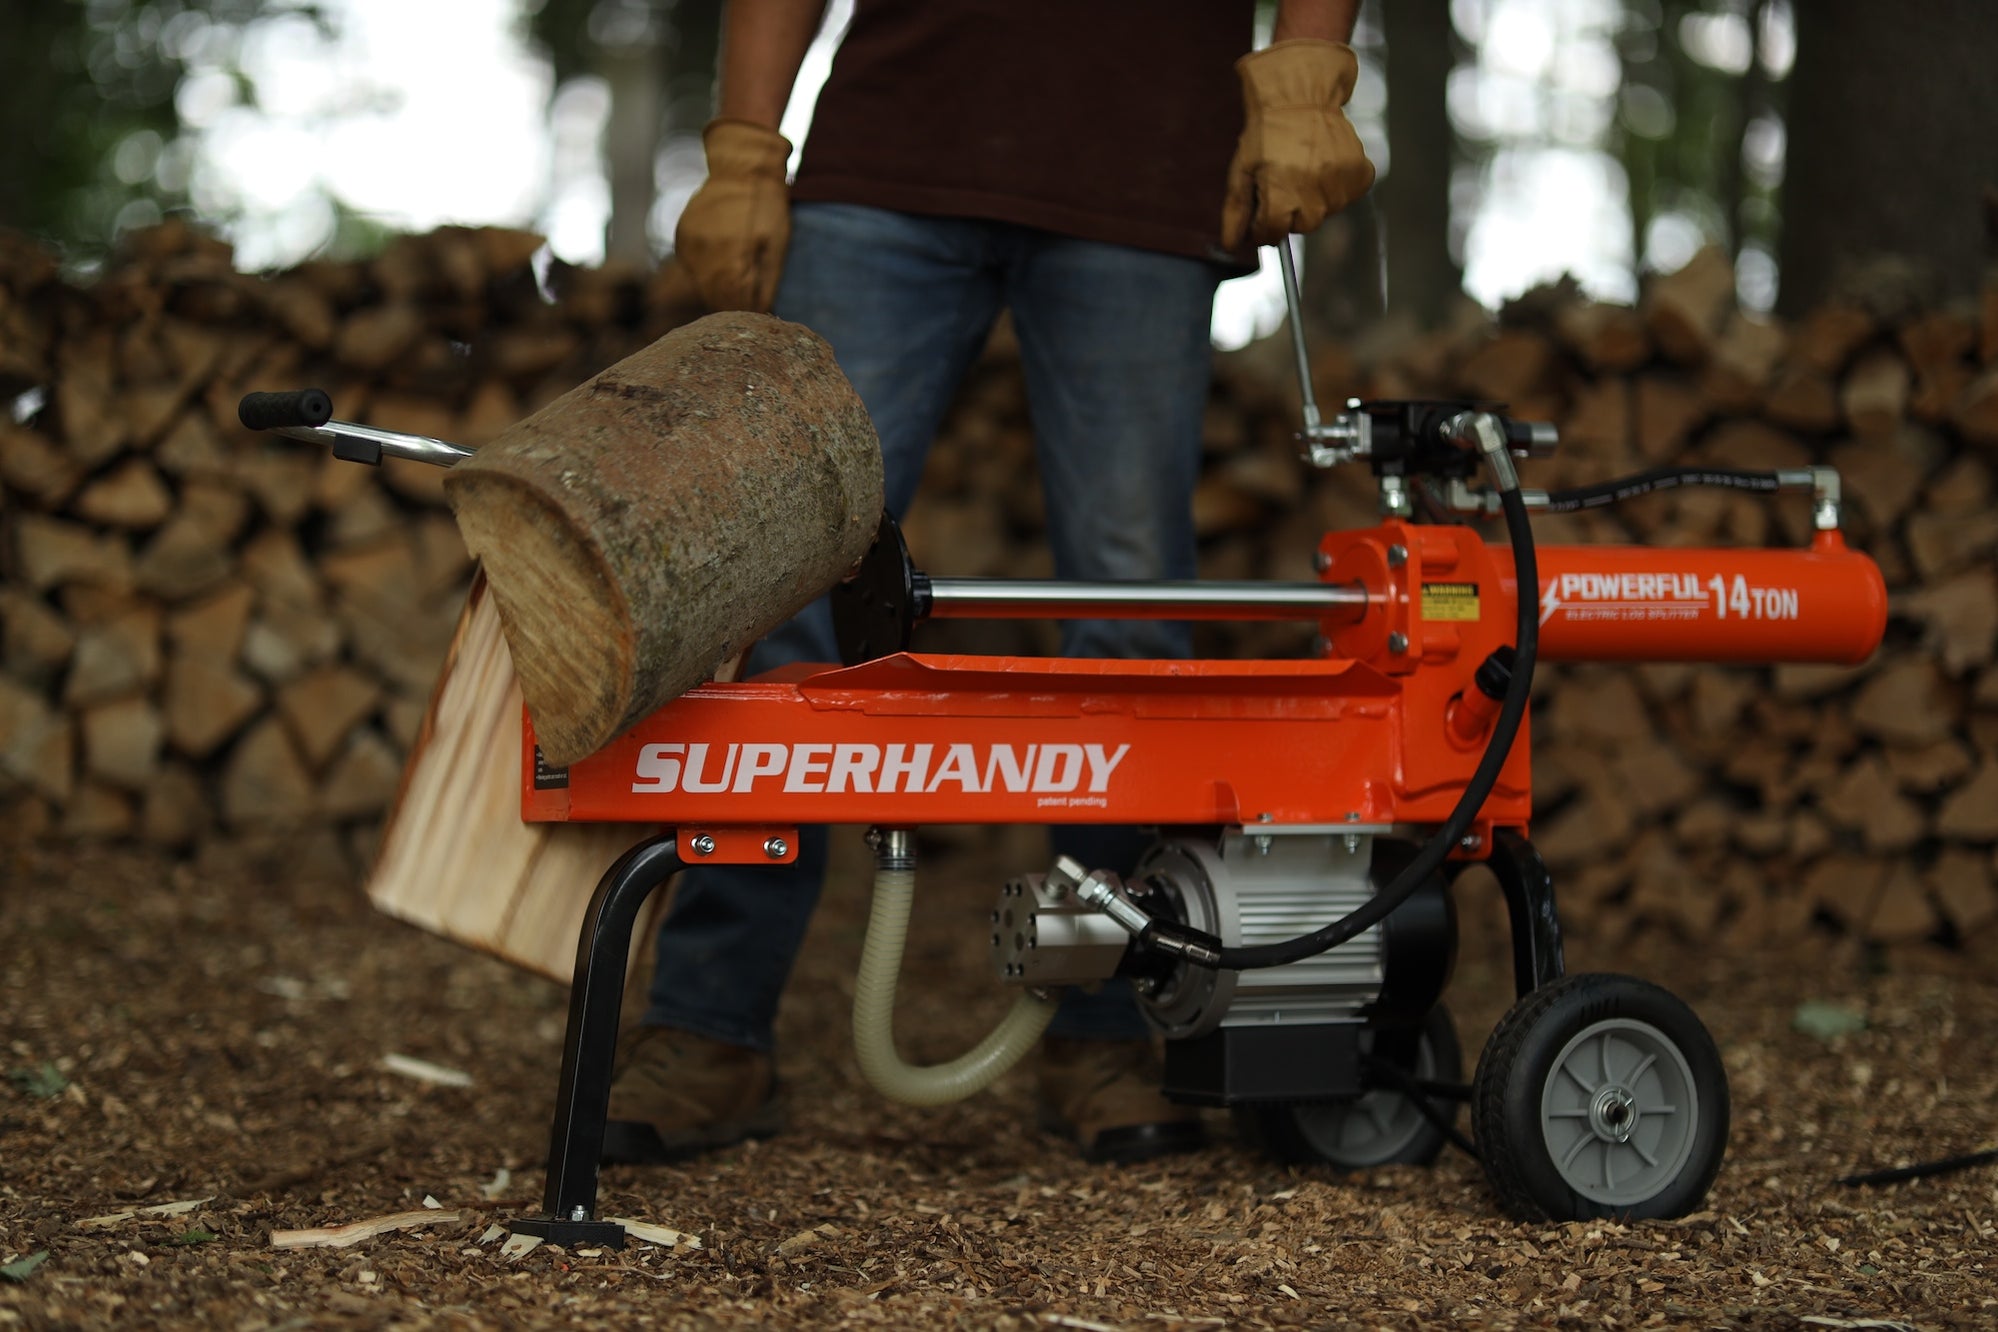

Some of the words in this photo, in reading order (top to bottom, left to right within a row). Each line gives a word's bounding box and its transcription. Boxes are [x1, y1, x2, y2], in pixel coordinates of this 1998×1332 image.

[1430, 584, 1474, 595] WARNING
[1561, 573, 1709, 600] POWERFUL
[1565, 609, 1619, 621] ELECTRIC
[1621, 609, 1646, 621] LOG
[1647, 609, 1699, 621] SPLITTER
[631, 743, 1131, 793] SUPERHANDY
[1037, 797, 1067, 808] patent
[1068, 796, 1108, 808] pending
